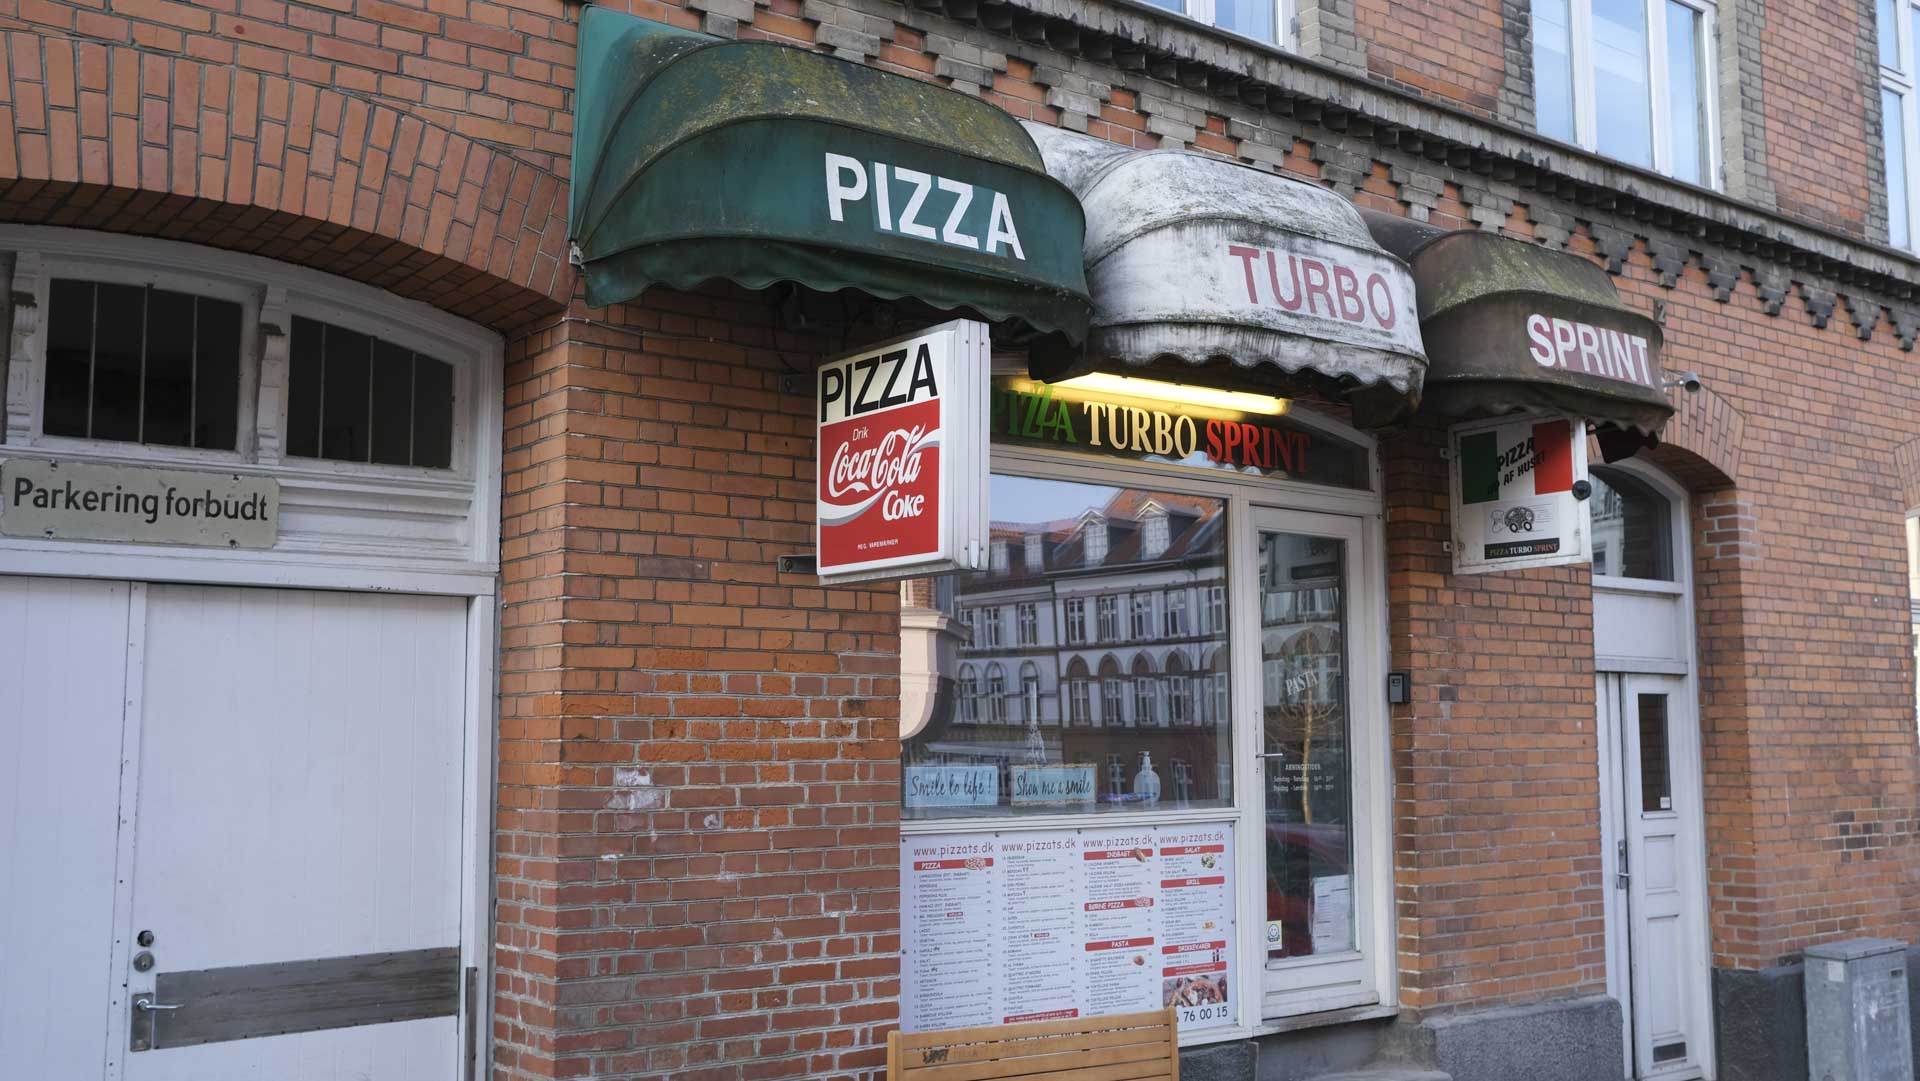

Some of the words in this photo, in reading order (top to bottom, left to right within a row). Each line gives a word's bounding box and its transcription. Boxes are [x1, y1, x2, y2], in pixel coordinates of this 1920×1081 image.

[825, 152, 1026, 261] PIZZA
[1229, 245, 1396, 330] TURBO
[1526, 313, 1651, 386] SPRINT
[821, 343, 938, 422] PIZZA
[852, 426, 869, 441] Drik
[990, 383, 1078, 444] PIZZA
[1083, 399, 1198, 459] TURBO
[1206, 418, 1312, 474] SPRINT
[828, 423, 927, 498] Coca-Cola
[1497, 437, 1536, 473] PIZZA
[1503, 469, 1515, 487] AF
[13, 477, 158, 524] Parkering
[165, 487, 268, 521] forbudt
[881, 489, 925, 521] Coke
[1489, 547, 1509, 557] PIZZA
[1510, 545, 1533, 554] TURBO
[1534, 543, 1558, 552] SPRINT
[1285, 670, 1319, 697] PASTA
[911, 774, 946, 797] Smile
[949, 774, 960, 796] to
[963, 771, 984, 800] life
[1042, 777, 1055, 793] me
[1066, 770, 1091, 795] smile
[914, 842, 994, 858] www.pizzats.dk
[1002, 838, 1076, 853] www.pizzats.dk
[1083, 834, 1153, 849] www.pizzats.dk
[1160, 831, 1224, 845] www.pizzats.dk
[921, 862, 941, 871] PIZZA
[1108, 901, 1125, 909] PIZZA
[1111, 940, 1130, 949] PASTA
[1183, 1010, 1196, 1023] 76
[1199, 1007, 1212, 1020] 00
[1216, 1005, 1228, 1018] 15
